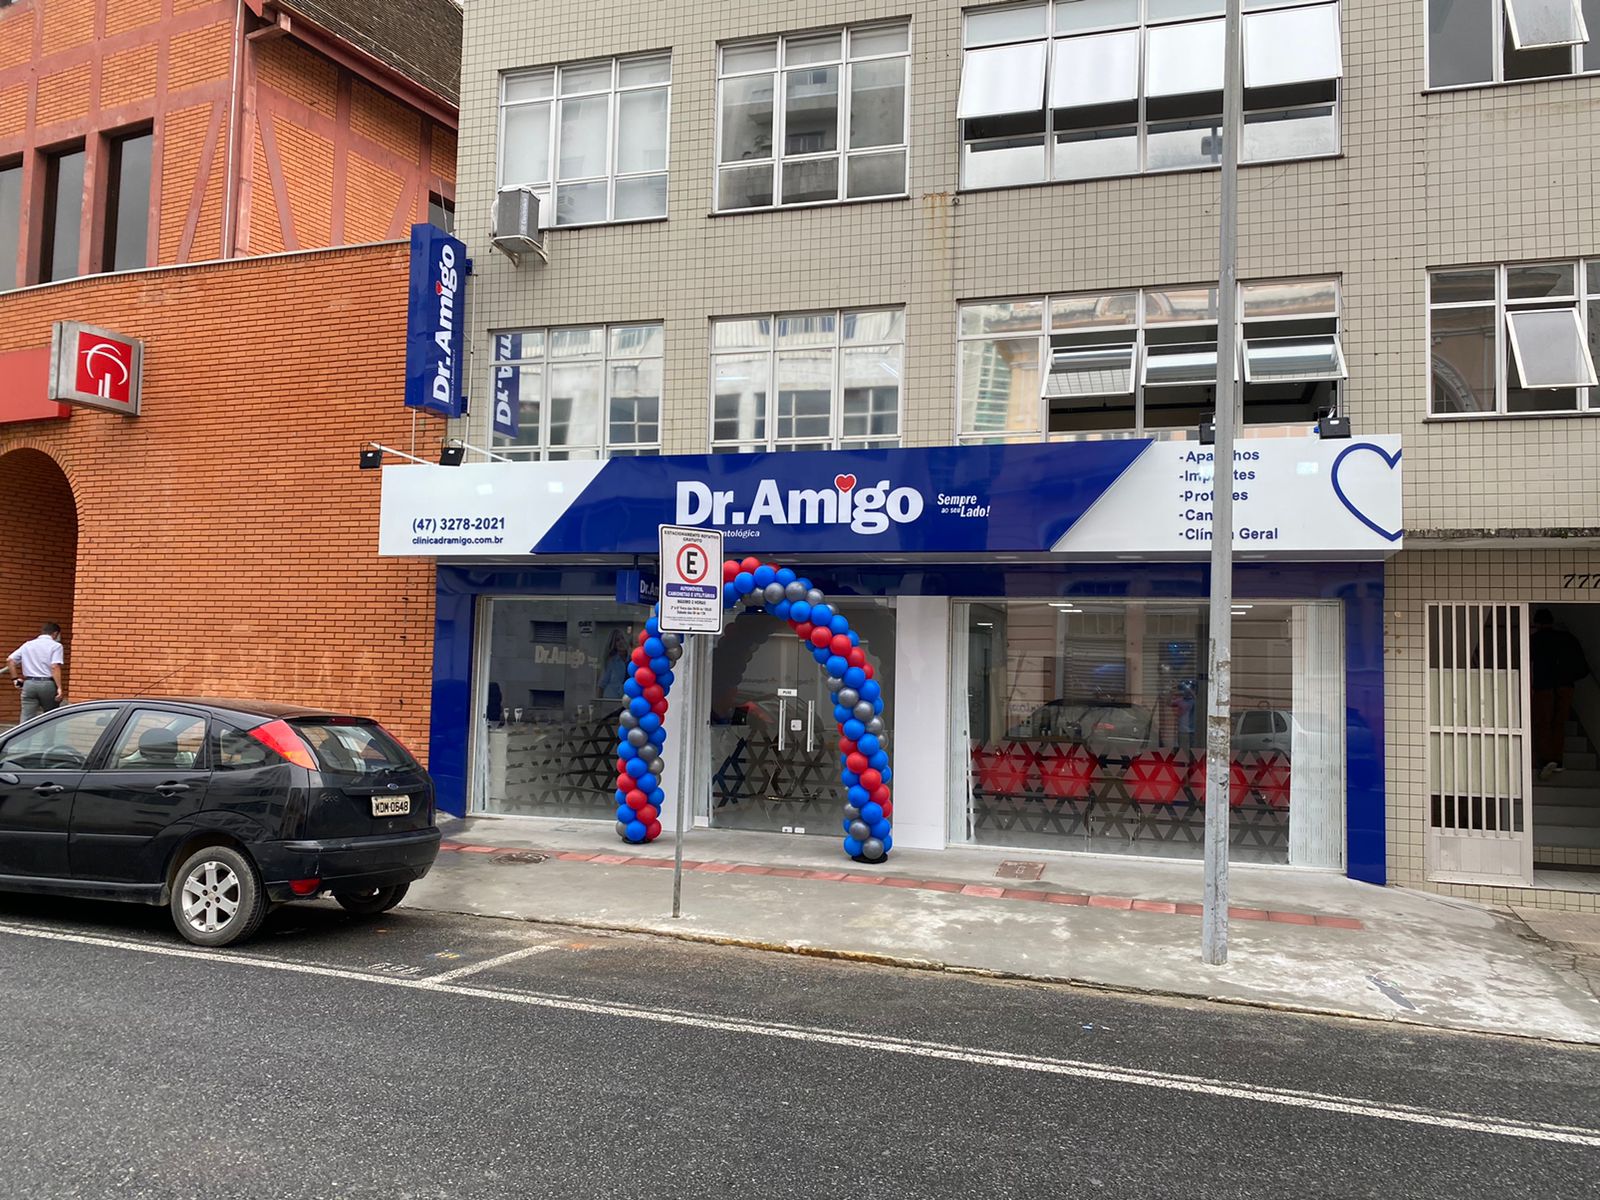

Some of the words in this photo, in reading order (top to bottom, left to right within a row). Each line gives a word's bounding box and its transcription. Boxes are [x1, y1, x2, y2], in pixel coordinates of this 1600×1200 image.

[432, 244, 458, 404] Dr.Amigo
[1179, 450, 1260, 464] -Apahos
[676, 474, 924, 535] Dr.Amigo
[937, 493, 977, 507] Sempre
[960, 505, 991, 518] Lado!
[412, 517, 437, 533] (47)
[440, 517, 505, 531] 3278-2021
[412, 536, 503, 546] clinicadramigo.com.br
[1239, 527, 1278, 540] Geral
[686, 551, 698, 574] E
[1564, 573, 1600, 589] 777
